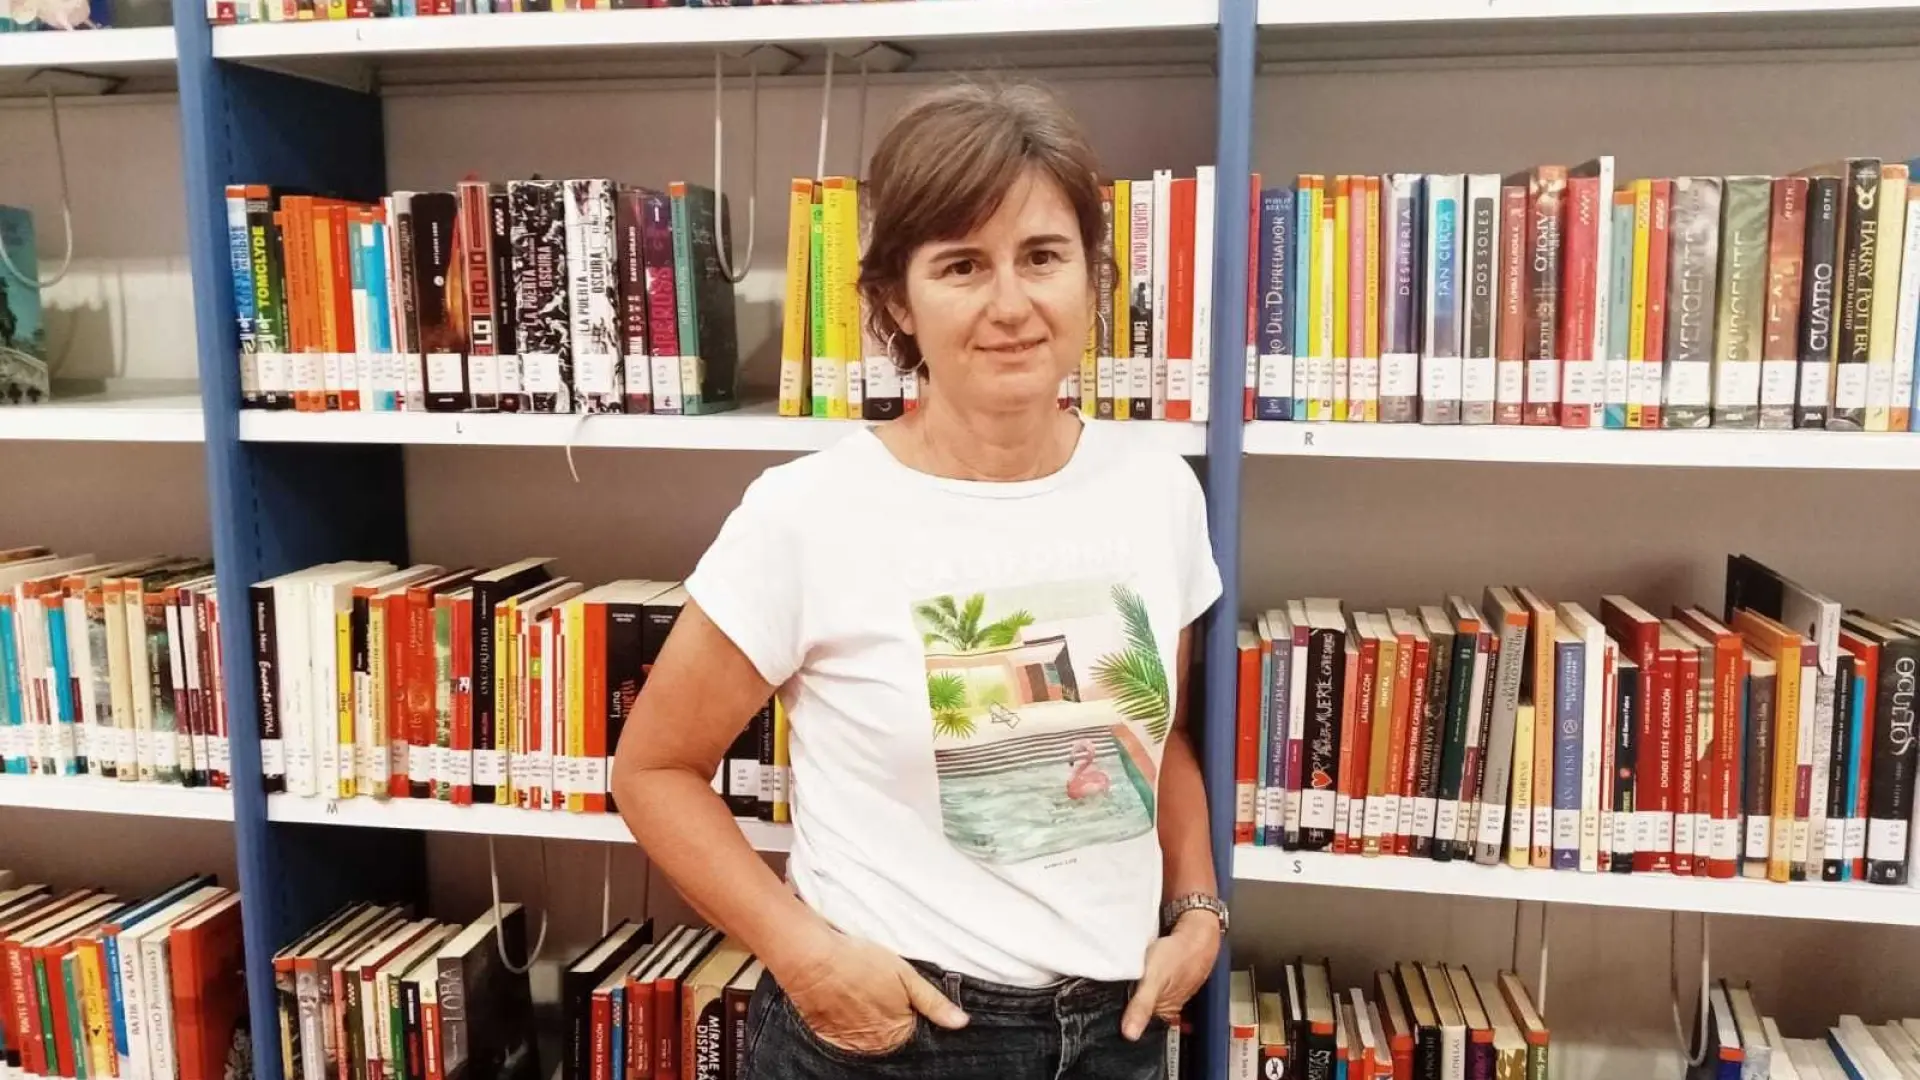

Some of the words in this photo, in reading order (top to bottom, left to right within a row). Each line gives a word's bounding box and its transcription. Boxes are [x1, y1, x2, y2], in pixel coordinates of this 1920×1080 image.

[1399, 208, 1411, 296] DESPIERTA
[1478, 209, 1489, 256] SOLES
[1857, 220, 1877, 281] HARRY
[252, 226, 271, 306] TOMCLYDE
[537, 246, 553, 288] OSCURA
[589, 251, 605, 293] OSCURA
[1438, 268, 1450, 296] TAN
[1475, 263, 1488, 296] DOS
[1810, 262, 1832, 350] CUATRO
[1822, 188, 1832, 220] ROTH
[521, 269, 538, 309] PUERTA
[576, 276, 589, 315] PUERTA
[1679, 230, 1705, 360] VERGENTE
[578, 317, 590, 333] LA
[1853, 288, 1873, 356] POTTER
[1303, 431, 1315, 446] R
[1660, 689, 1671, 728] CORAZÓN
[1659, 741, 1669, 759] ESTÉ
[1661, 759, 1669, 788] DONDE
[1292, 859, 1304, 875] S
[124, 953, 135, 983] ALAS
[442, 966, 463, 1022] LOBA
[696, 1025, 708, 1080] DISPARA
[708, 1015, 721, 1071] MÍRAME
